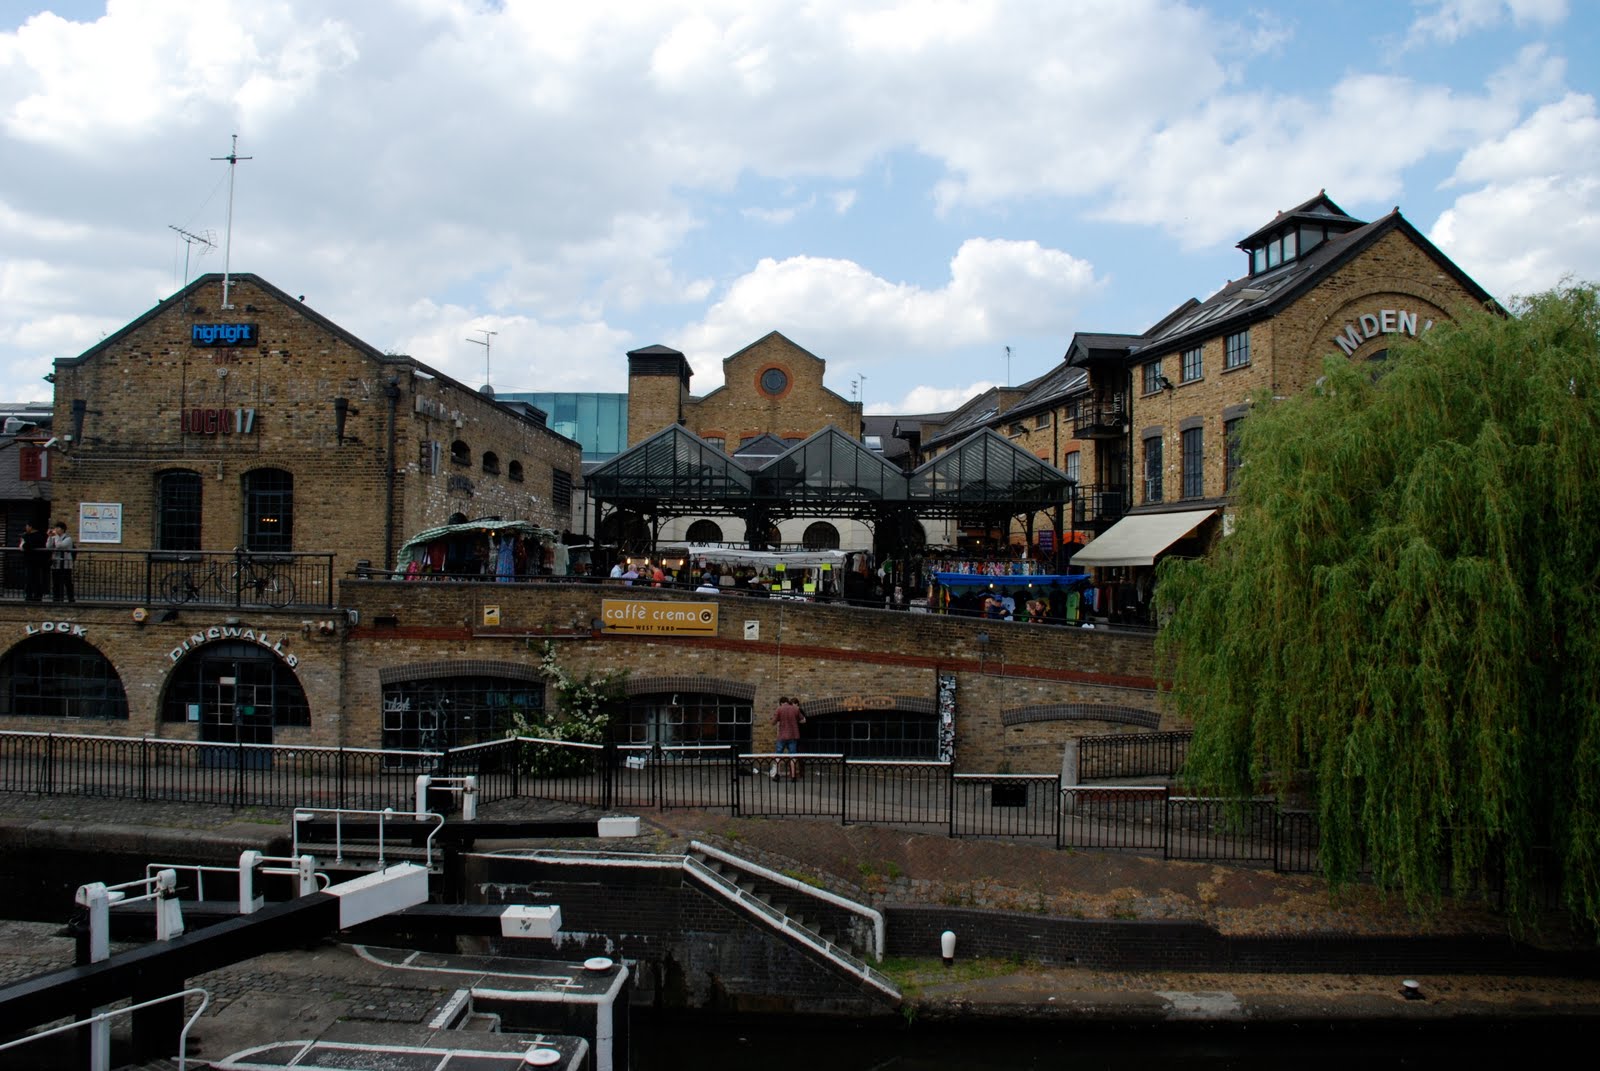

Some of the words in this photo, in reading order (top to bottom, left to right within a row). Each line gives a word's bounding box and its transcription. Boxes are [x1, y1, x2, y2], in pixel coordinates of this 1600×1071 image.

[193, 324, 252, 344] highlight
[1334, 309, 1418, 357] MDEN
[181, 408, 230, 434] LOCK
[234, 408, 256, 434] 17
[606, 604, 647, 620] caffè
[653, 610, 696, 621] crema
[25, 621, 88, 637] LOCK
[169, 626, 299, 669] DINGWALLS
